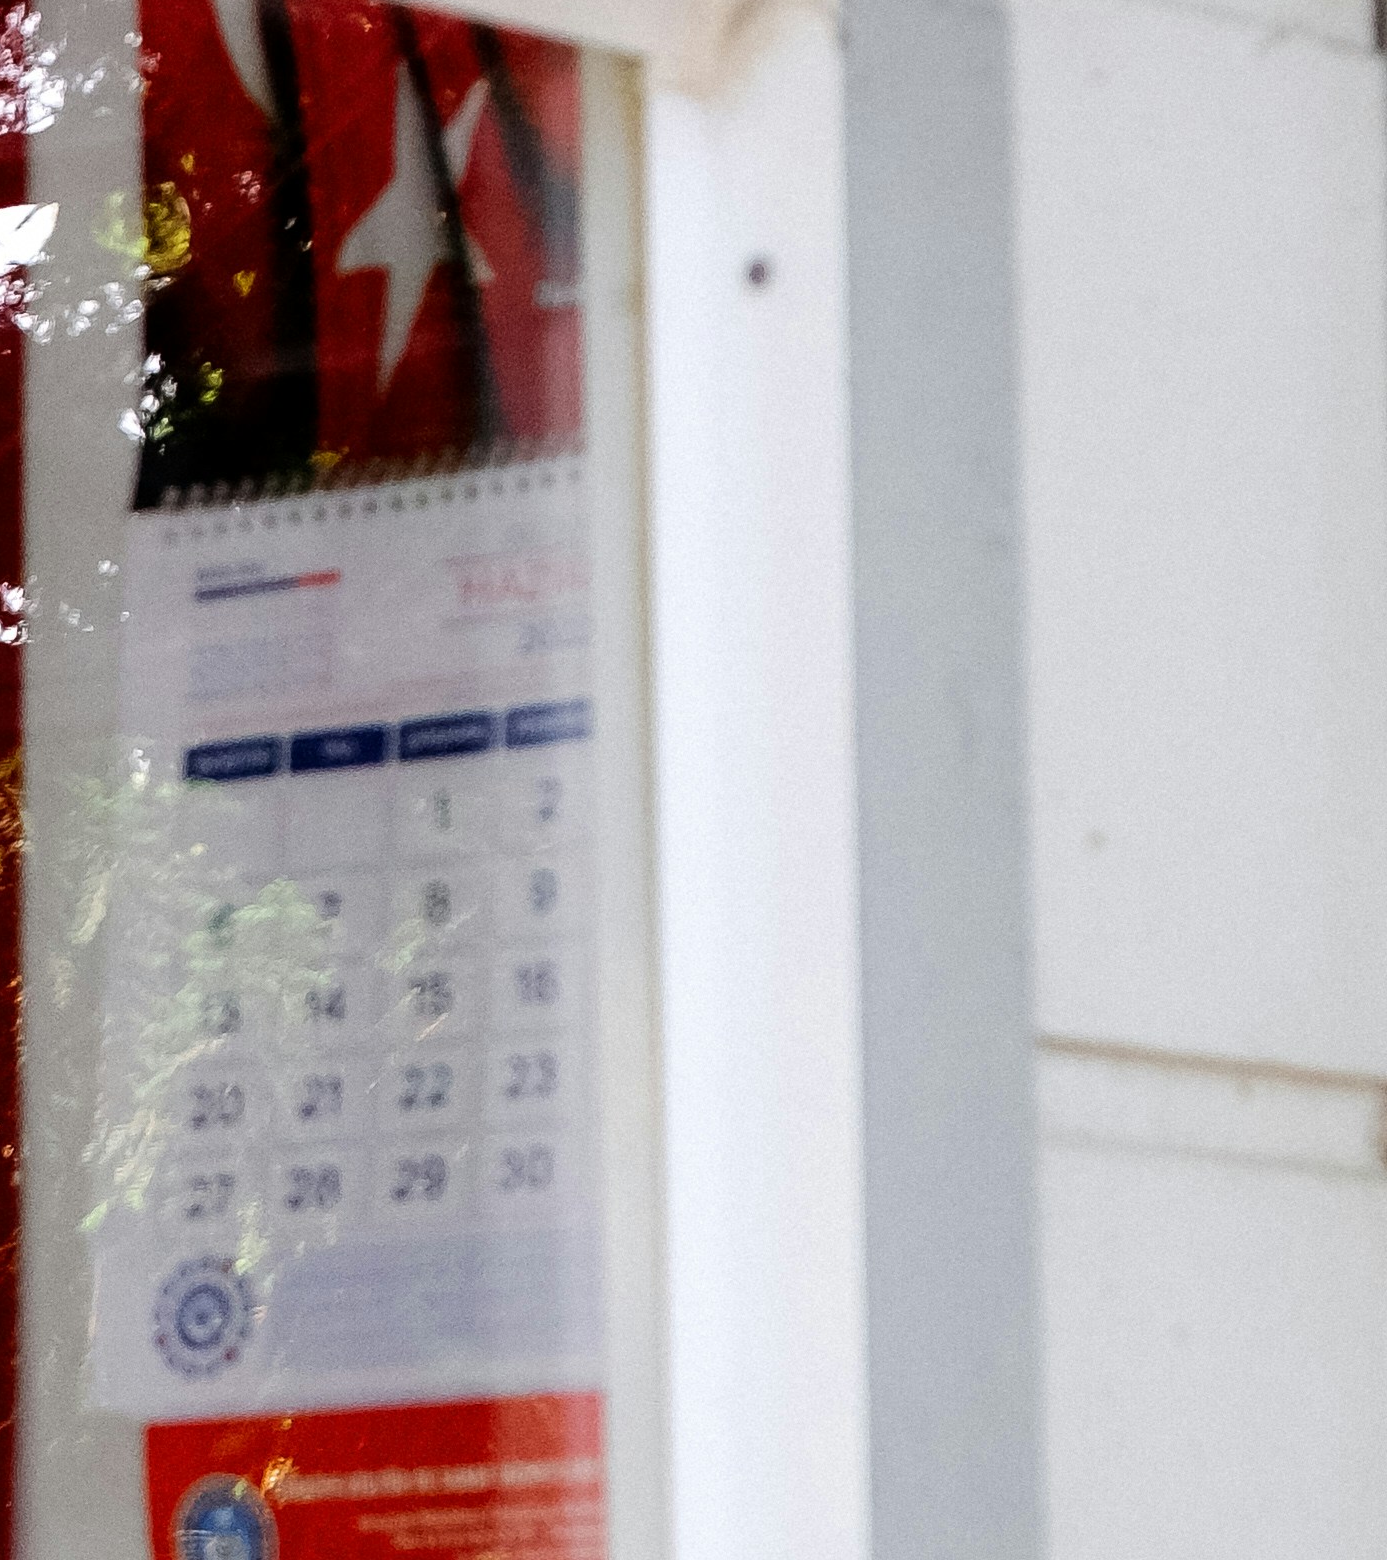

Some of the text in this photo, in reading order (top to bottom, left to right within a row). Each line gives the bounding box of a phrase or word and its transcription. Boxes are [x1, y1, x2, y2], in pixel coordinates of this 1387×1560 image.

[188, 1050, 560, 1131] 20 21 22 23
[184, 1142, 556, 1220] 27 28 29 30
